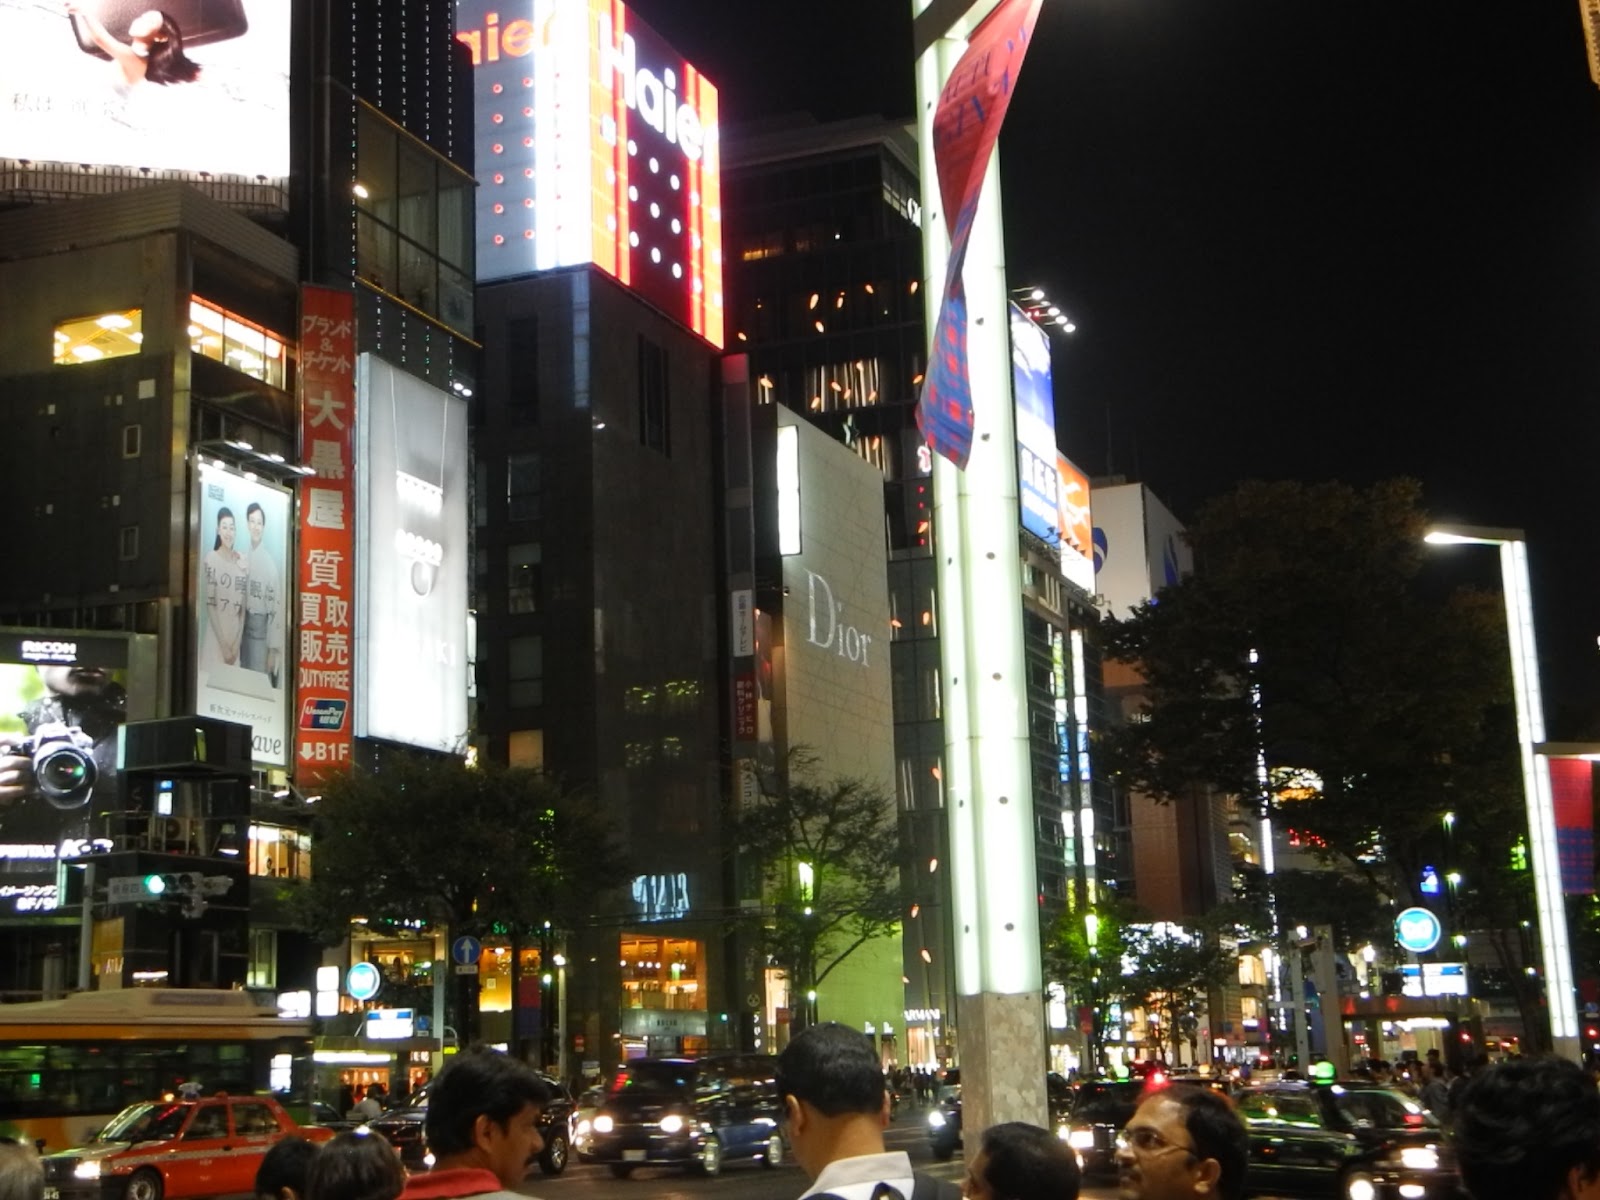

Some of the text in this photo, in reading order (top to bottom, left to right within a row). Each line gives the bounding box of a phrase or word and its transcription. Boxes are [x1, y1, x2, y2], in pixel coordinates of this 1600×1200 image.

[599, 11, 719, 175] Haier
[303, 315, 352, 339] ブランド
[320, 338, 334, 352] &
[303, 350, 352, 374] チケット
[307, 549, 344, 591] 質
[301, 592, 349, 629] 買取
[803, 567, 872, 668] Dior
[22, 640, 77, 654] RICOH
[301, 630, 349, 666] 販売
[316, 742, 349, 761] B1F
